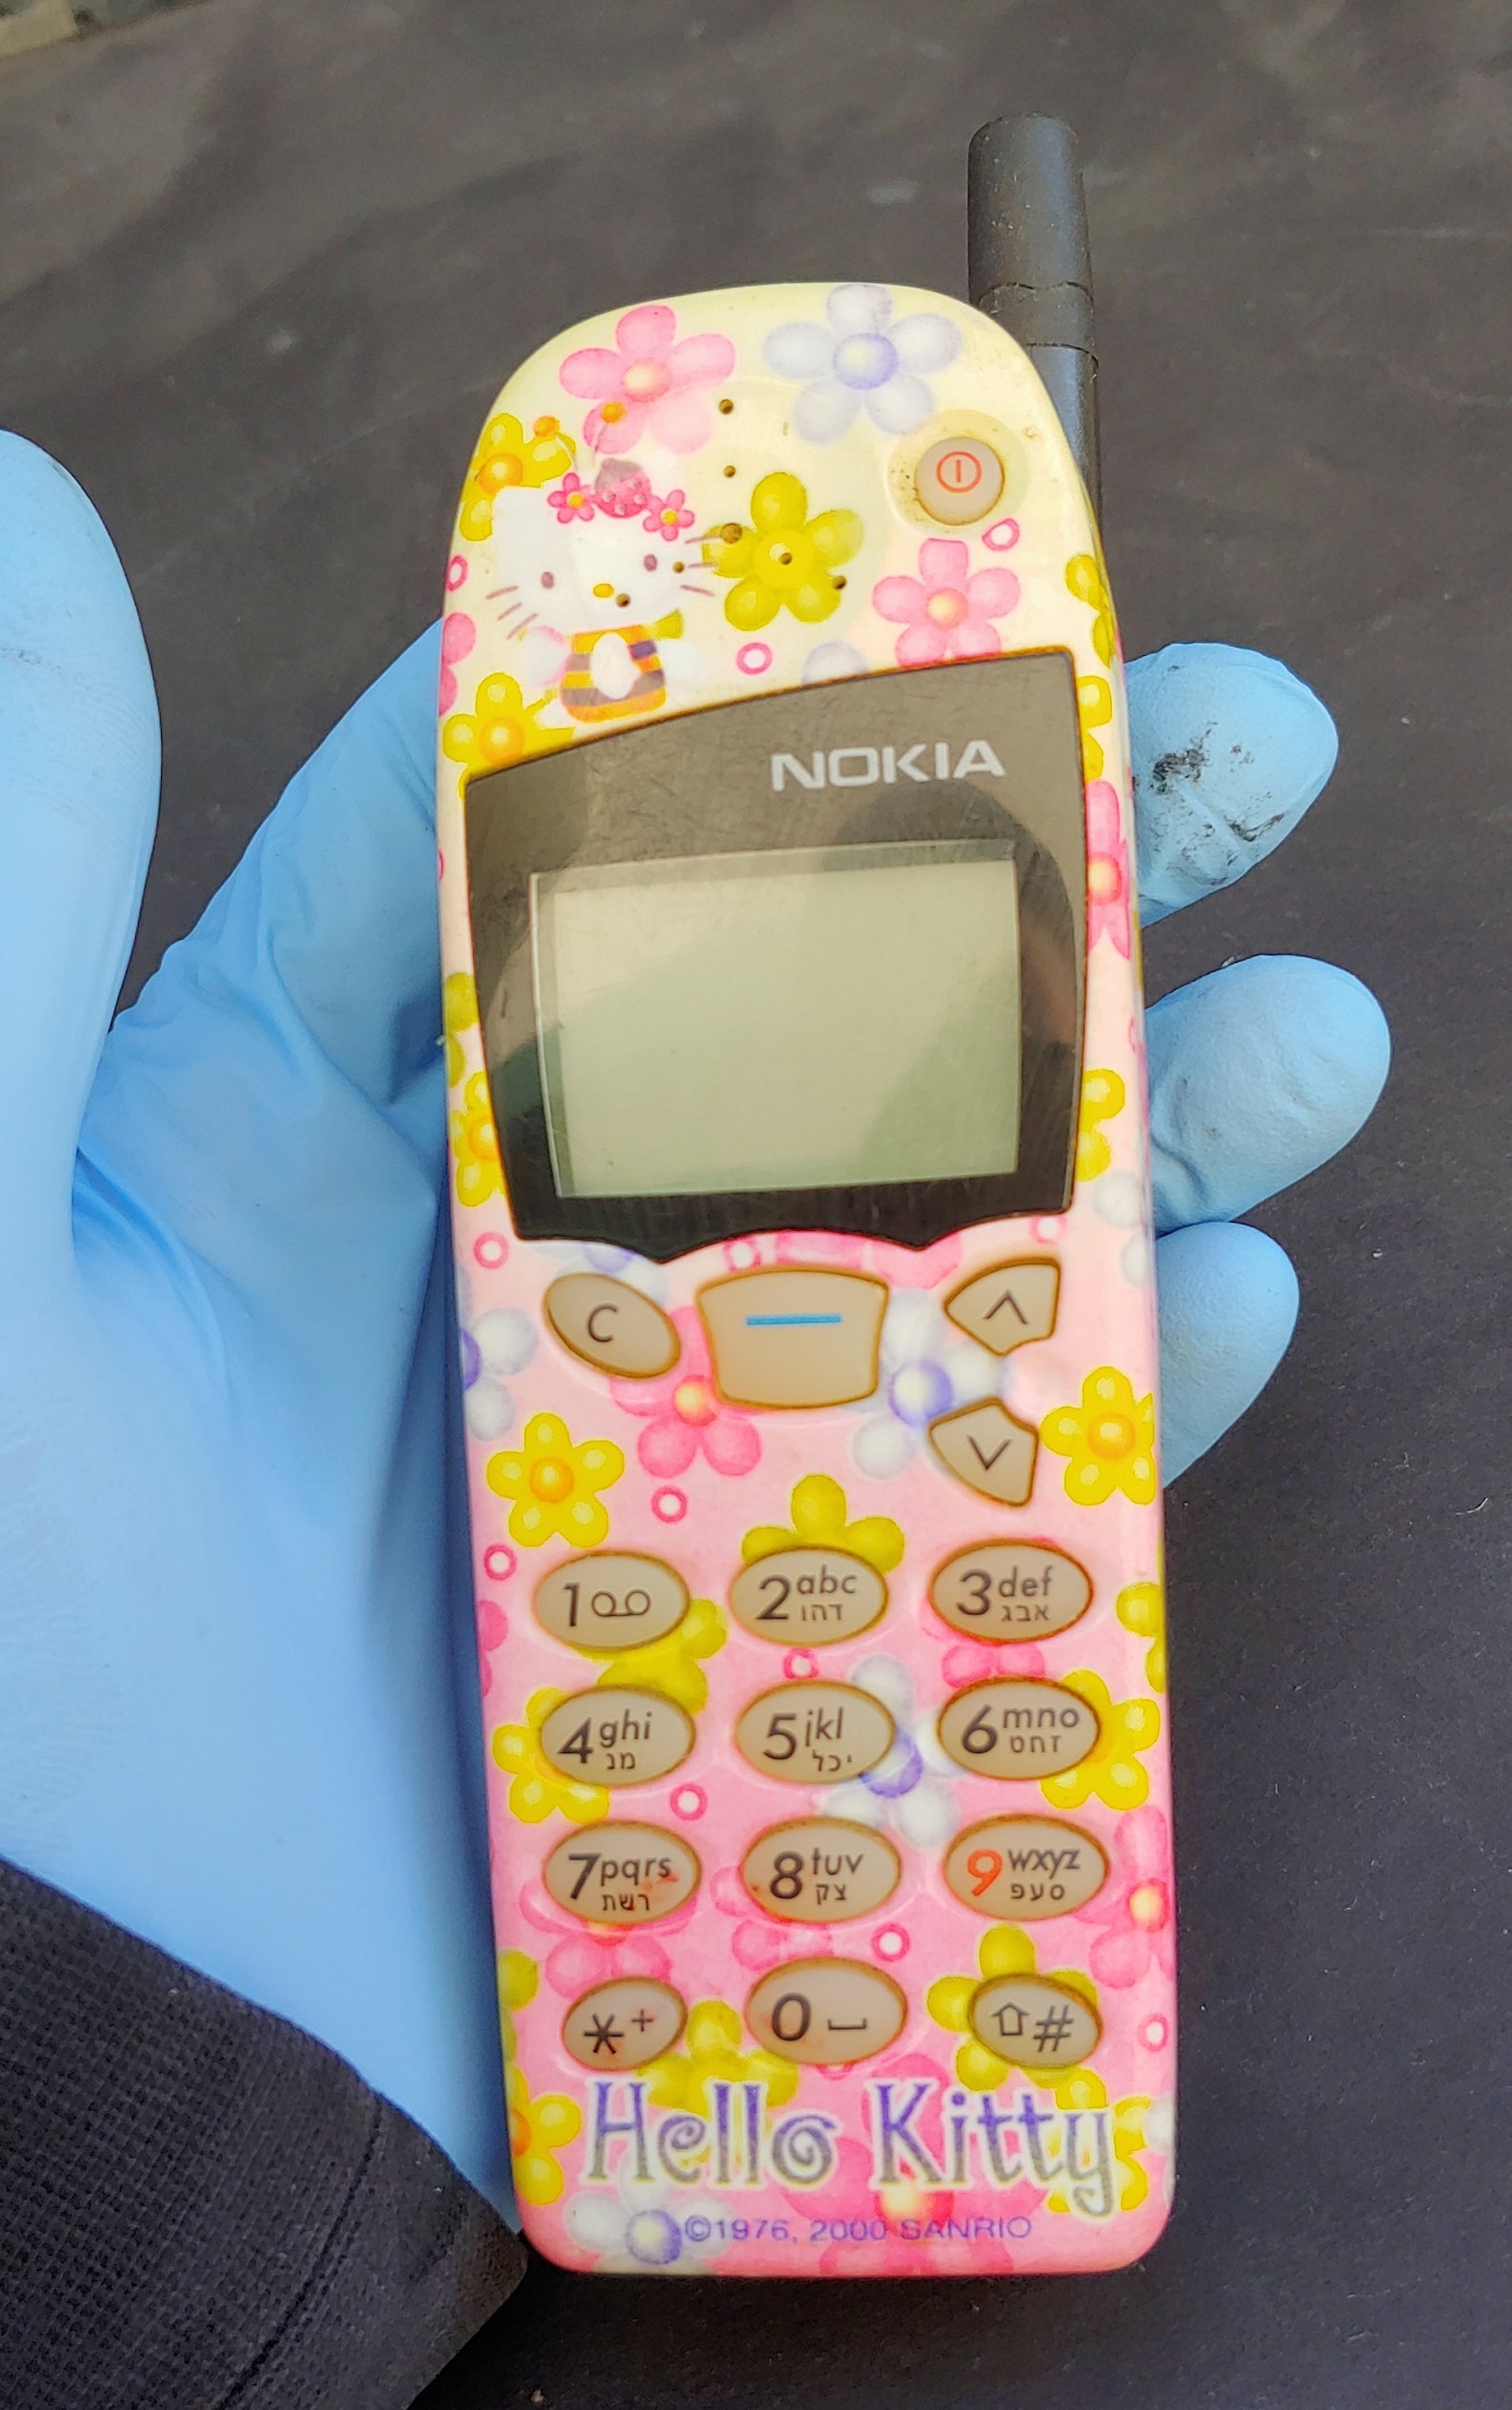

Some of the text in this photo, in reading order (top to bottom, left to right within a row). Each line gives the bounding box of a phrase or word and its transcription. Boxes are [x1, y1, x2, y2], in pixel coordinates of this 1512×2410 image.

[770, 740, 1005, 792] NOKIA
[587, 1304, 620, 1344] C
[563, 1583, 580, 1627] 1
[757, 1564, 857, 1622] 2 abc
[800, 1603, 844, 1623] דהו
[958, 1564, 1054, 1617] 3 def
[1001, 1603, 1050, 1623] אבג
[558, 1709, 653, 1764] 4 ghi
[765, 1705, 844, 1762] 5 jkl
[961, 1703, 1081, 1756] 6 mno
[567, 1852, 672, 1901] 7 pqrs
[768, 1845, 865, 1901] 8 tuv
[965, 1847, 1082, 1897] 9 wxyz
[587, 2081, 1110, 2217] Hello Kitty
[809, 2217, 889, 2242] 2000
[897, 2215, 1032, 2241] SANRIO
